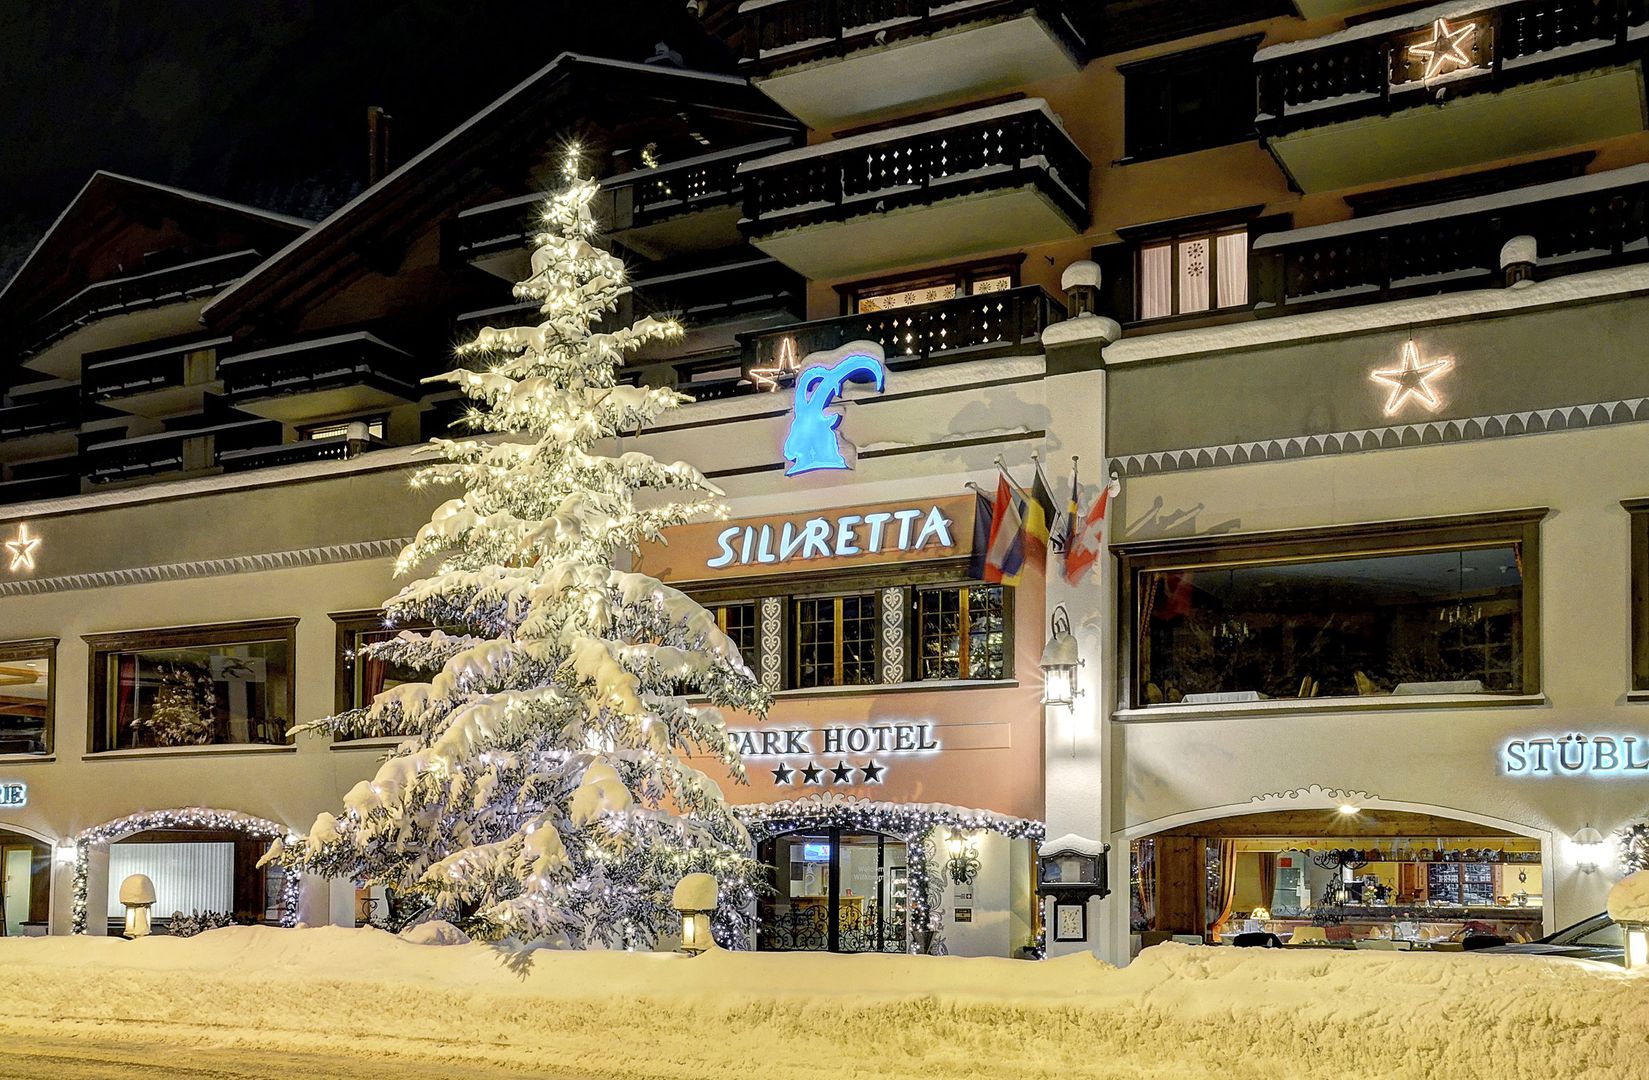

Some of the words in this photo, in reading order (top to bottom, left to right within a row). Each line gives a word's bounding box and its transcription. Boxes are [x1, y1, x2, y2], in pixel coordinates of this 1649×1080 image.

[706, 505, 953, 568] SILVRETTA
[822, 724, 938, 753] HOTEL
[1507, 733, 1649, 772] STÜBL
[0, 784, 24, 805] IE
